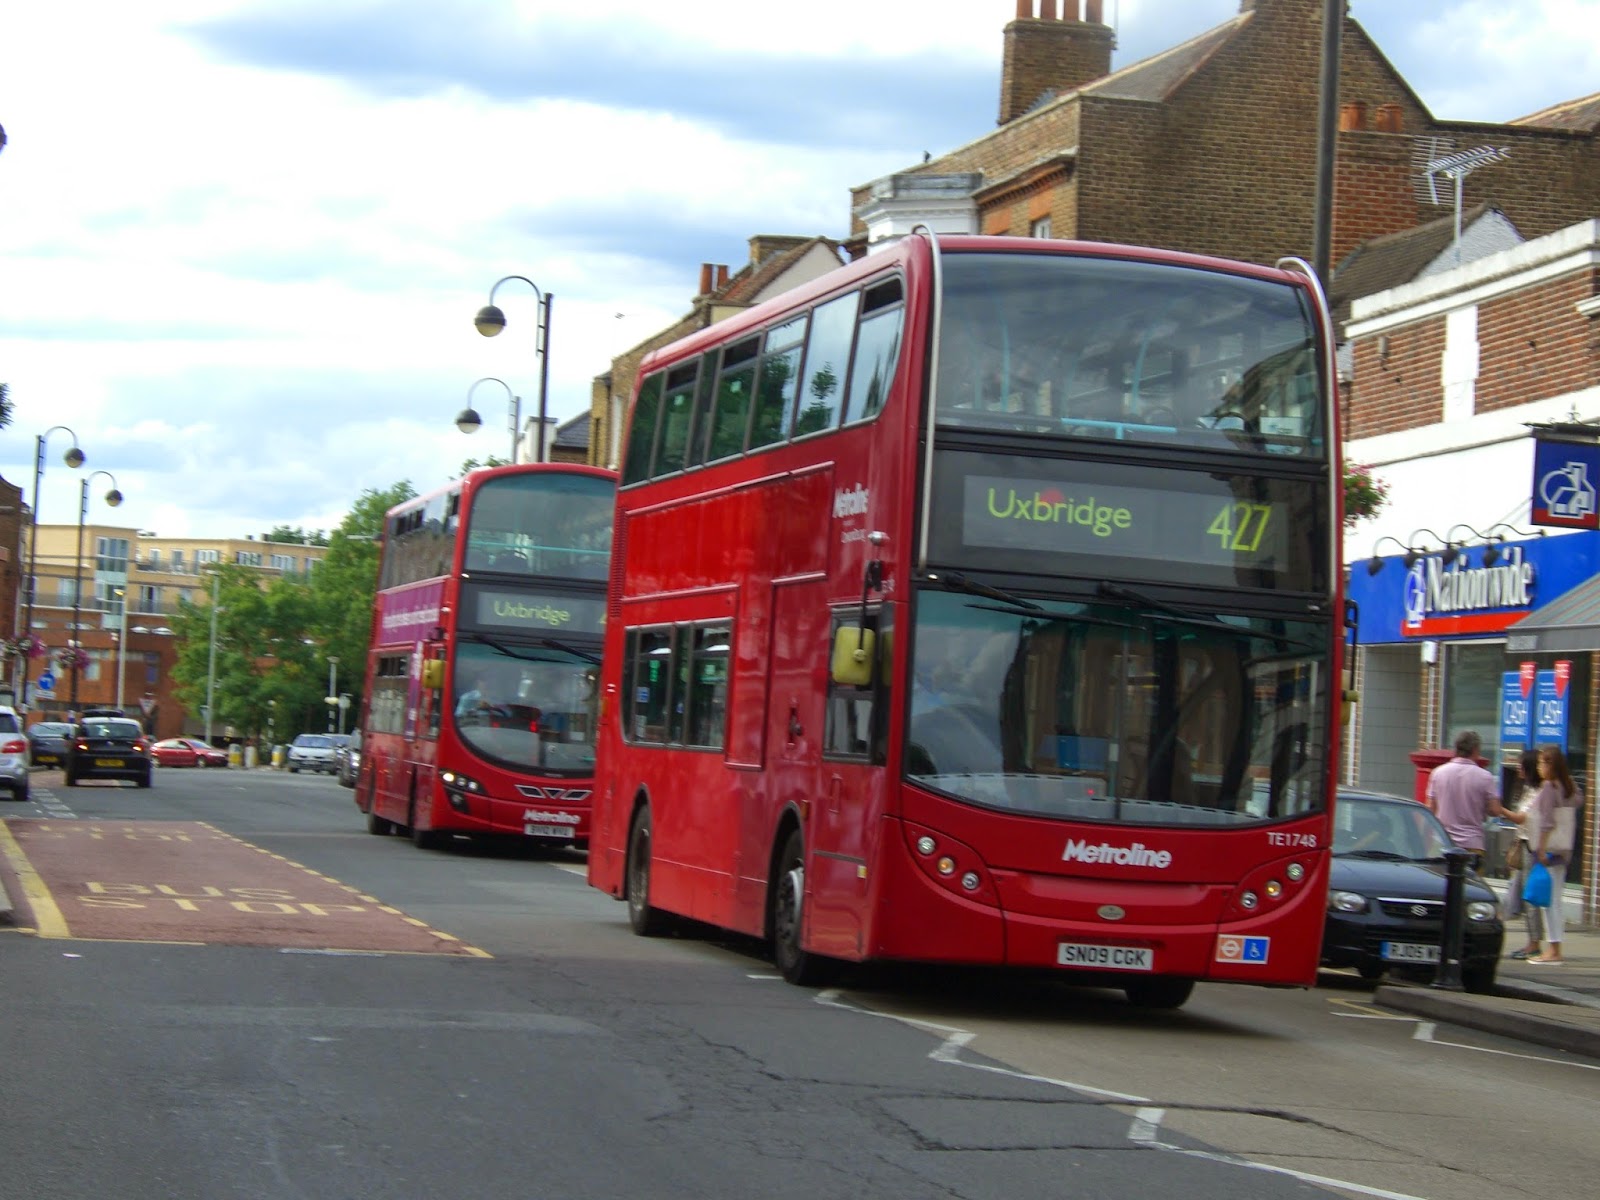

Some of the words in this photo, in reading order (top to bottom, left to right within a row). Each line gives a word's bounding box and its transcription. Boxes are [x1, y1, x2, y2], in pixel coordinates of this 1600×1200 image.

[987, 487, 1133, 537] Uxbridge
[1206, 502, 1272, 551] 427
[1425, 546, 1534, 612] Nationwide
[493, 600, 571, 626] Uxbridge
[523, 808, 581, 825] Metroline
[1267, 832, 1317, 848] TE1748
[1062, 838, 1172, 869] Metroline
[85, 881, 297, 900] BUS
[77, 895, 368, 916] STOP
[1065, 946, 1108, 963] SN09
[1113, 949, 1146, 966] CGK
